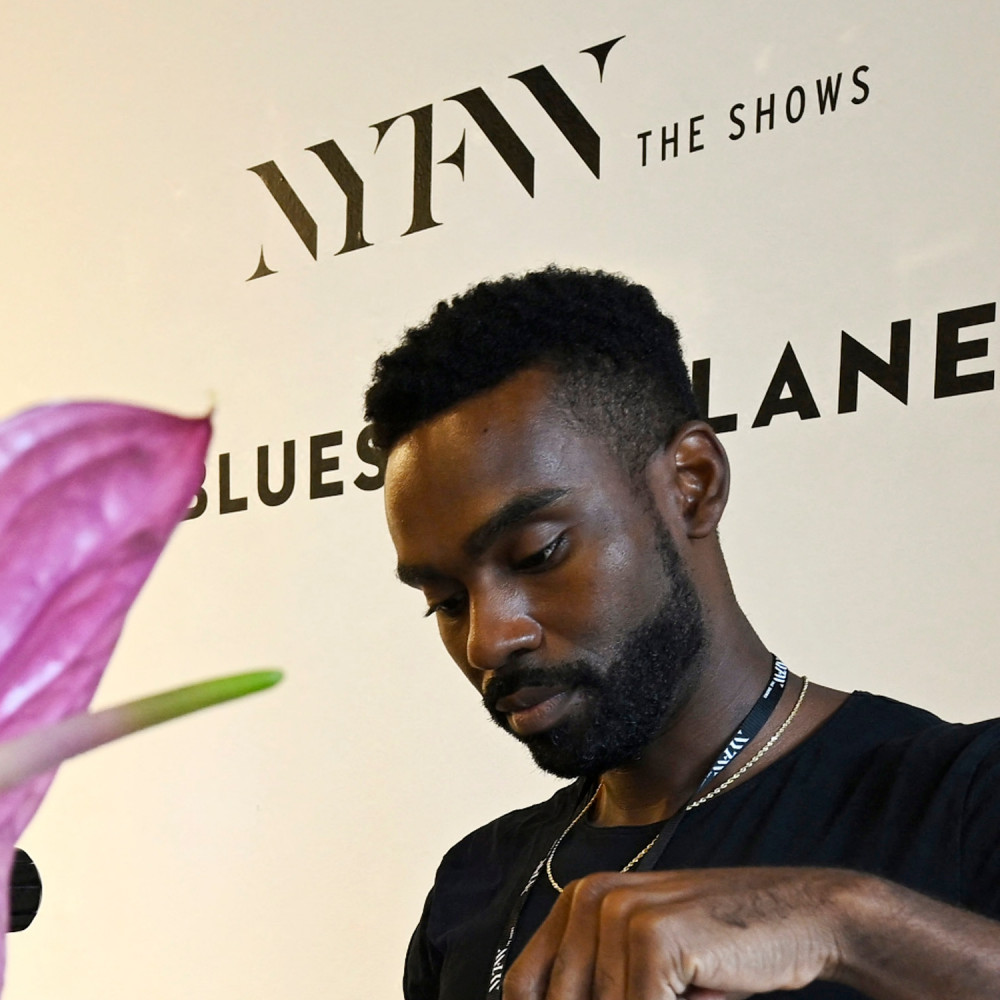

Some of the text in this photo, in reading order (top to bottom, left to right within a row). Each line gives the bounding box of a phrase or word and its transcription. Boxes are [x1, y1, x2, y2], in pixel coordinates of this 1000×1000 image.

[245, 34, 870, 282] NYFW THE SHOWS
[691, 301, 997, 435] LANE
